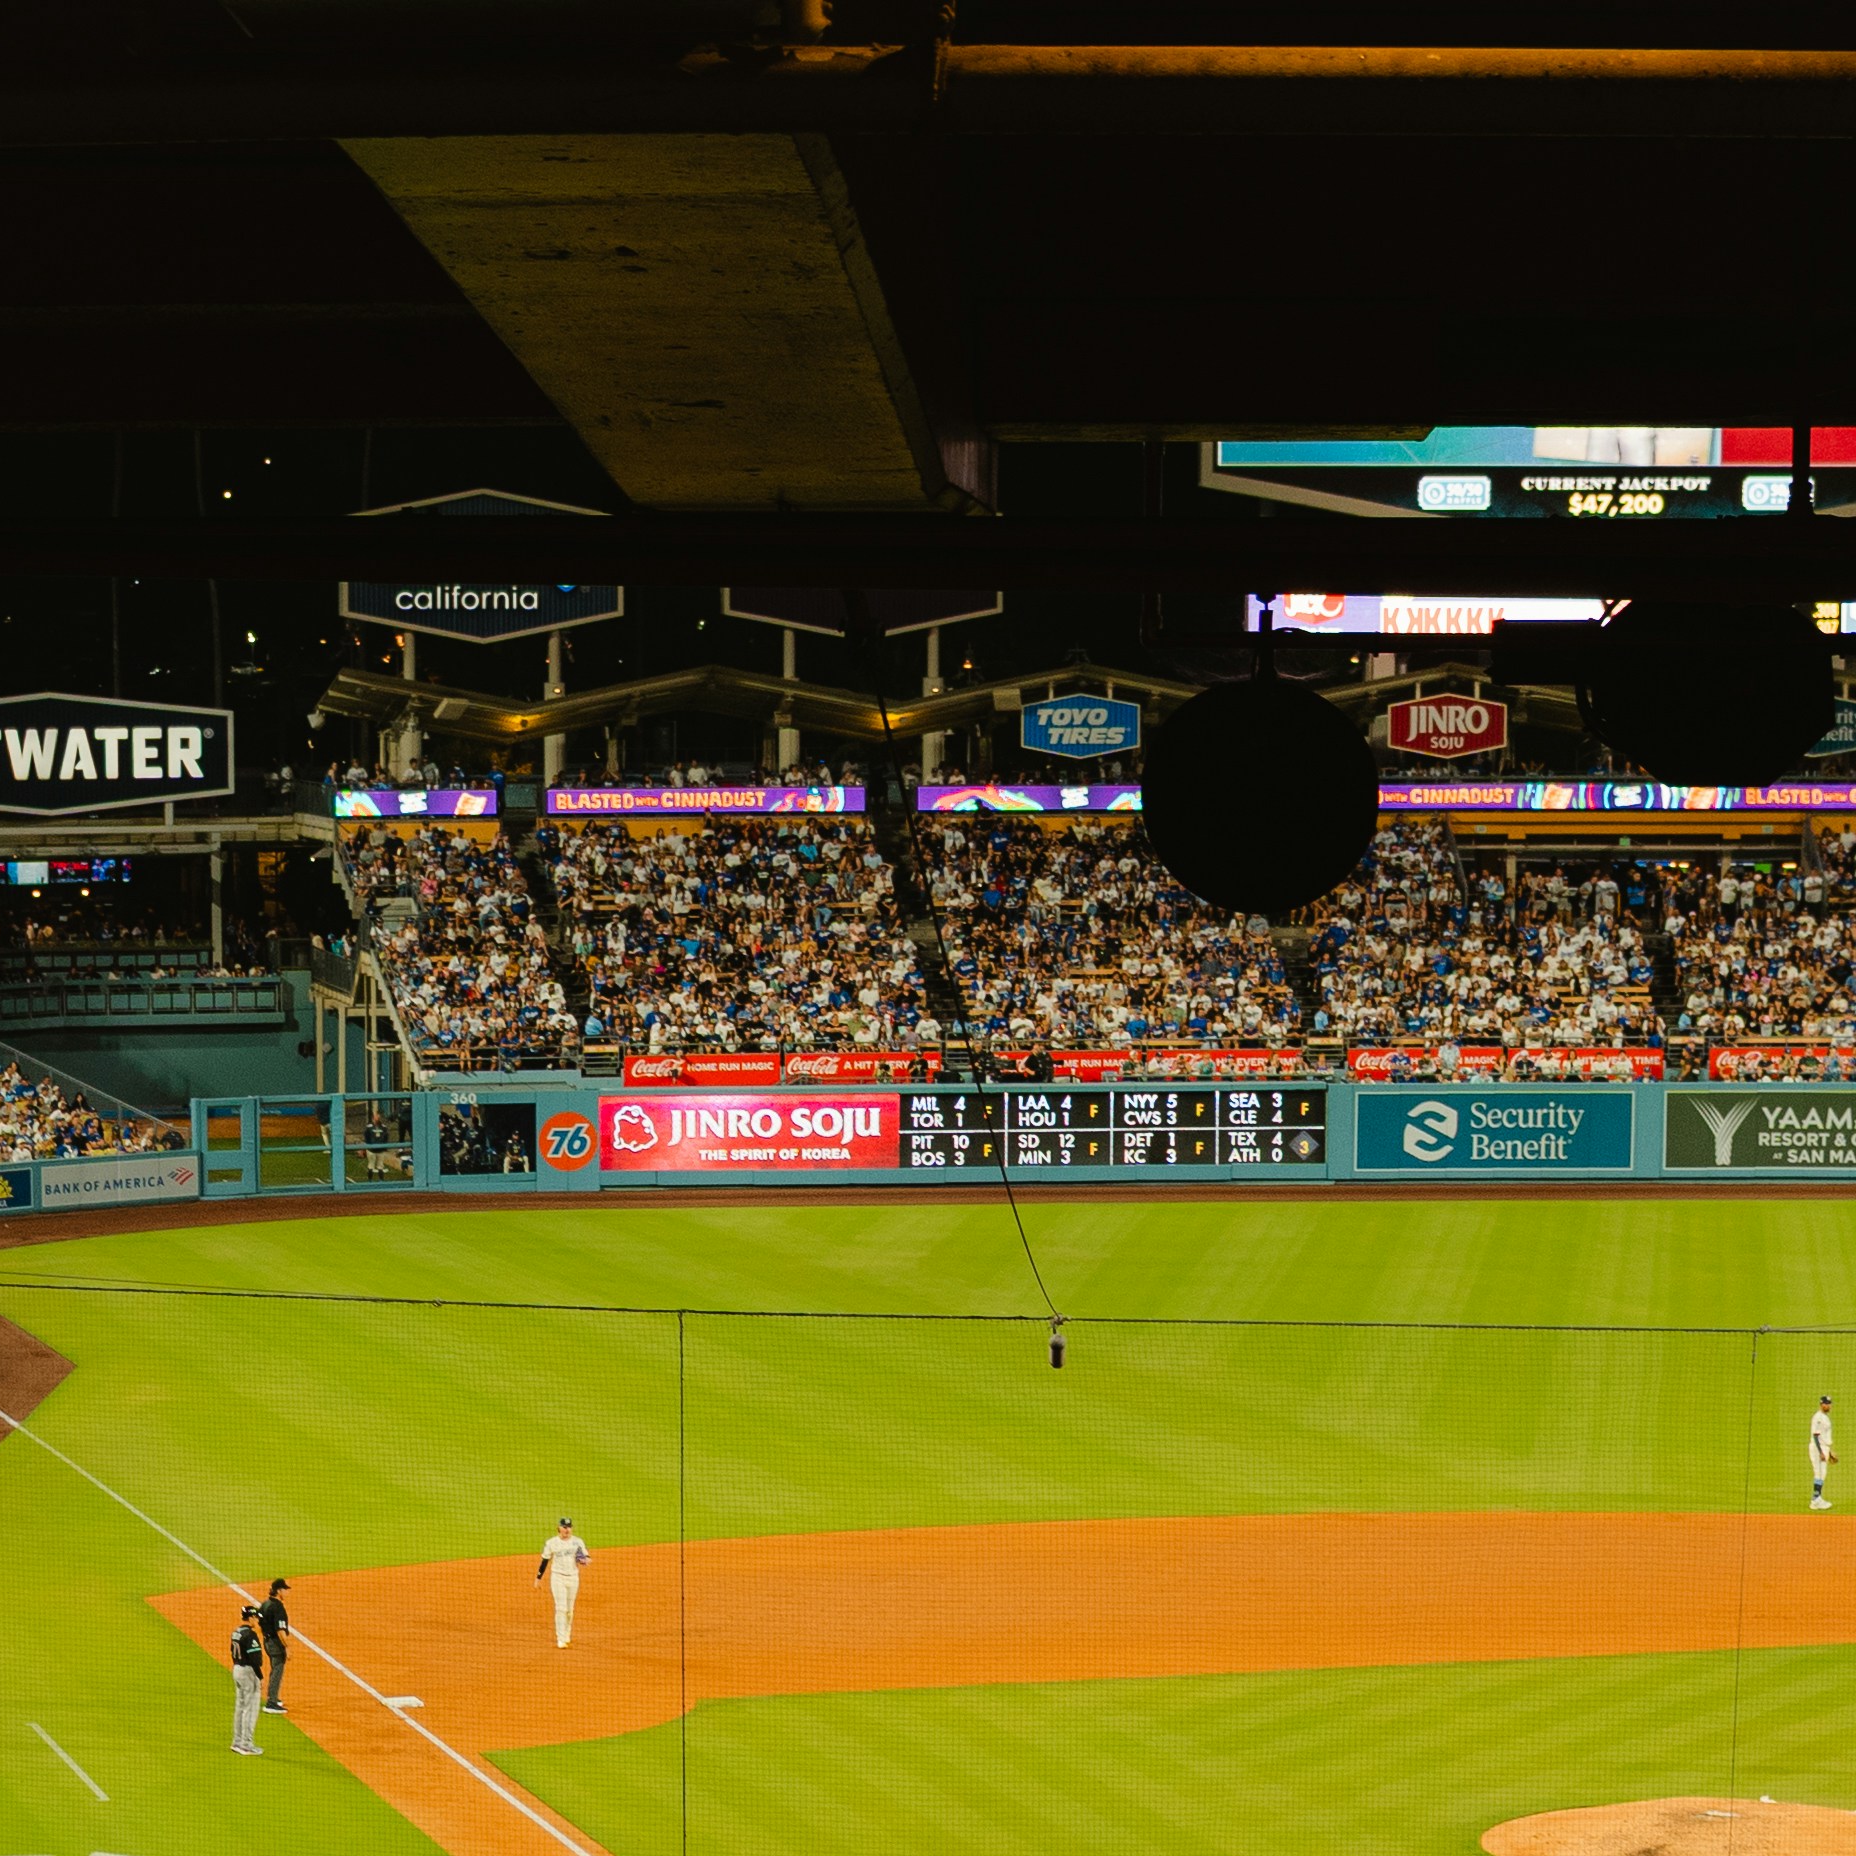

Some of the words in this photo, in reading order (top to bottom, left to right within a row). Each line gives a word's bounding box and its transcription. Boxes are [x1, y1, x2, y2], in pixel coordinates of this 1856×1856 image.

[1521, 477, 1616, 491] CURRENT
[1618, 477, 1711, 491] JACKPOT
[1568, 494, 1664, 517] $47,200
[396, 586, 538, 610] california
[1037, 708, 1108, 726] TOYO
[1406, 705, 1489, 742] JINRO
[1048, 727, 1125, 744] TIRES
[1431, 736, 1464, 750] SOJU
[556, 792, 634, 809] BLASTED
[661, 792, 765, 808] CINNADUST
[1409, 788, 1514, 804] CINNADUST
[1745, 788, 1823, 805] BLASTED
[687, 1062, 715, 1071] HOME
[719, 1061, 740, 1071] RUN
[742, 1061, 774, 1070] MAGIC
[854, 1060, 872, 1069] HIT
[1635, 1056, 1660, 1065] TIME
[450, 1093, 477, 1105] 360
[911, 1096, 941, 1112] MIL
[954, 1096, 966, 1111] 4
[984, 1105, 992, 1119] F
[1018, 1095, 1050, 1112] LAA
[1060, 1096, 1072, 1111] 4
[1090, 1105, 1098, 1119] F
[1124, 1094, 1158, 1110] NYY
[1167, 1094, 1177, 1110] 5
[1196, 1104, 1205, 1117] F
[1229, 1093, 1260, 1109] SEA
[1272, 1094, 1282, 1109] 3
[1301, 1103, 1310, 1116] F
[911, 1113, 944, 1128] TOR
[956, 1113, 963, 1128] 1
[1018, 1112, 1056, 1128] HOU
[1063, 1112, 1070, 1127] 1
[1124, 1111, 1162, 1126] CWS
[1167, 1111, 1177, 1126] 3
[1229, 1110, 1257, 1125] CLE
[1271, 1110, 1283, 1125] 4
[1470, 1102, 1585, 1134] Security
[668, 1108, 782, 1147] JINRO
[789, 1108, 882, 1144] SOJU
[546, 1125, 589, 1159] 76
[911, 1135, 933, 1150] PIT
[953, 1134, 970, 1150] 10
[984, 1144, 992, 1158] F
[1018, 1134, 1040, 1149] SD
[1059, 1133, 1076, 1149] 12
[1090, 1142, 1098, 1156] F
[1124, 1132, 1154, 1147] DET
[1169, 1132, 1176, 1147] 1
[1196, 1142, 1205, 1155] F
[1229, 1131, 1257, 1146] TEX
[1271, 1131, 1283, 1146] 4
[1300, 1140, 1309, 1155] 3
[1470, 1134, 1568, 1160] Benefit
[1758, 1133, 1831, 1147] RESORT
[1834, 1133, 1847, 1147] &
[699, 1149, 727, 1161] THE
[730, 1148, 774, 1161] SPIRIT
[776, 1148, 792, 1161] OF
[795, 1148, 851, 1161] KOREA
[911, 1151, 946, 1167] BOS
[954, 1151, 965, 1166] 3
[1018, 1150, 1051, 1165] MIN
[1061, 1150, 1071, 1165] 3
[1124, 1149, 1147, 1164] KC
[1166, 1149, 1177, 1164] 3
[1229, 1148, 1261, 1163] ATH
[1271, 1148, 1283, 1163] 0
[1787, 1150, 1831, 1164] SAN
[45, 1182, 81, 1196] BANK
[84, 1180, 101, 1193] OF
[103, 1176, 165, 1192] AMERICA
